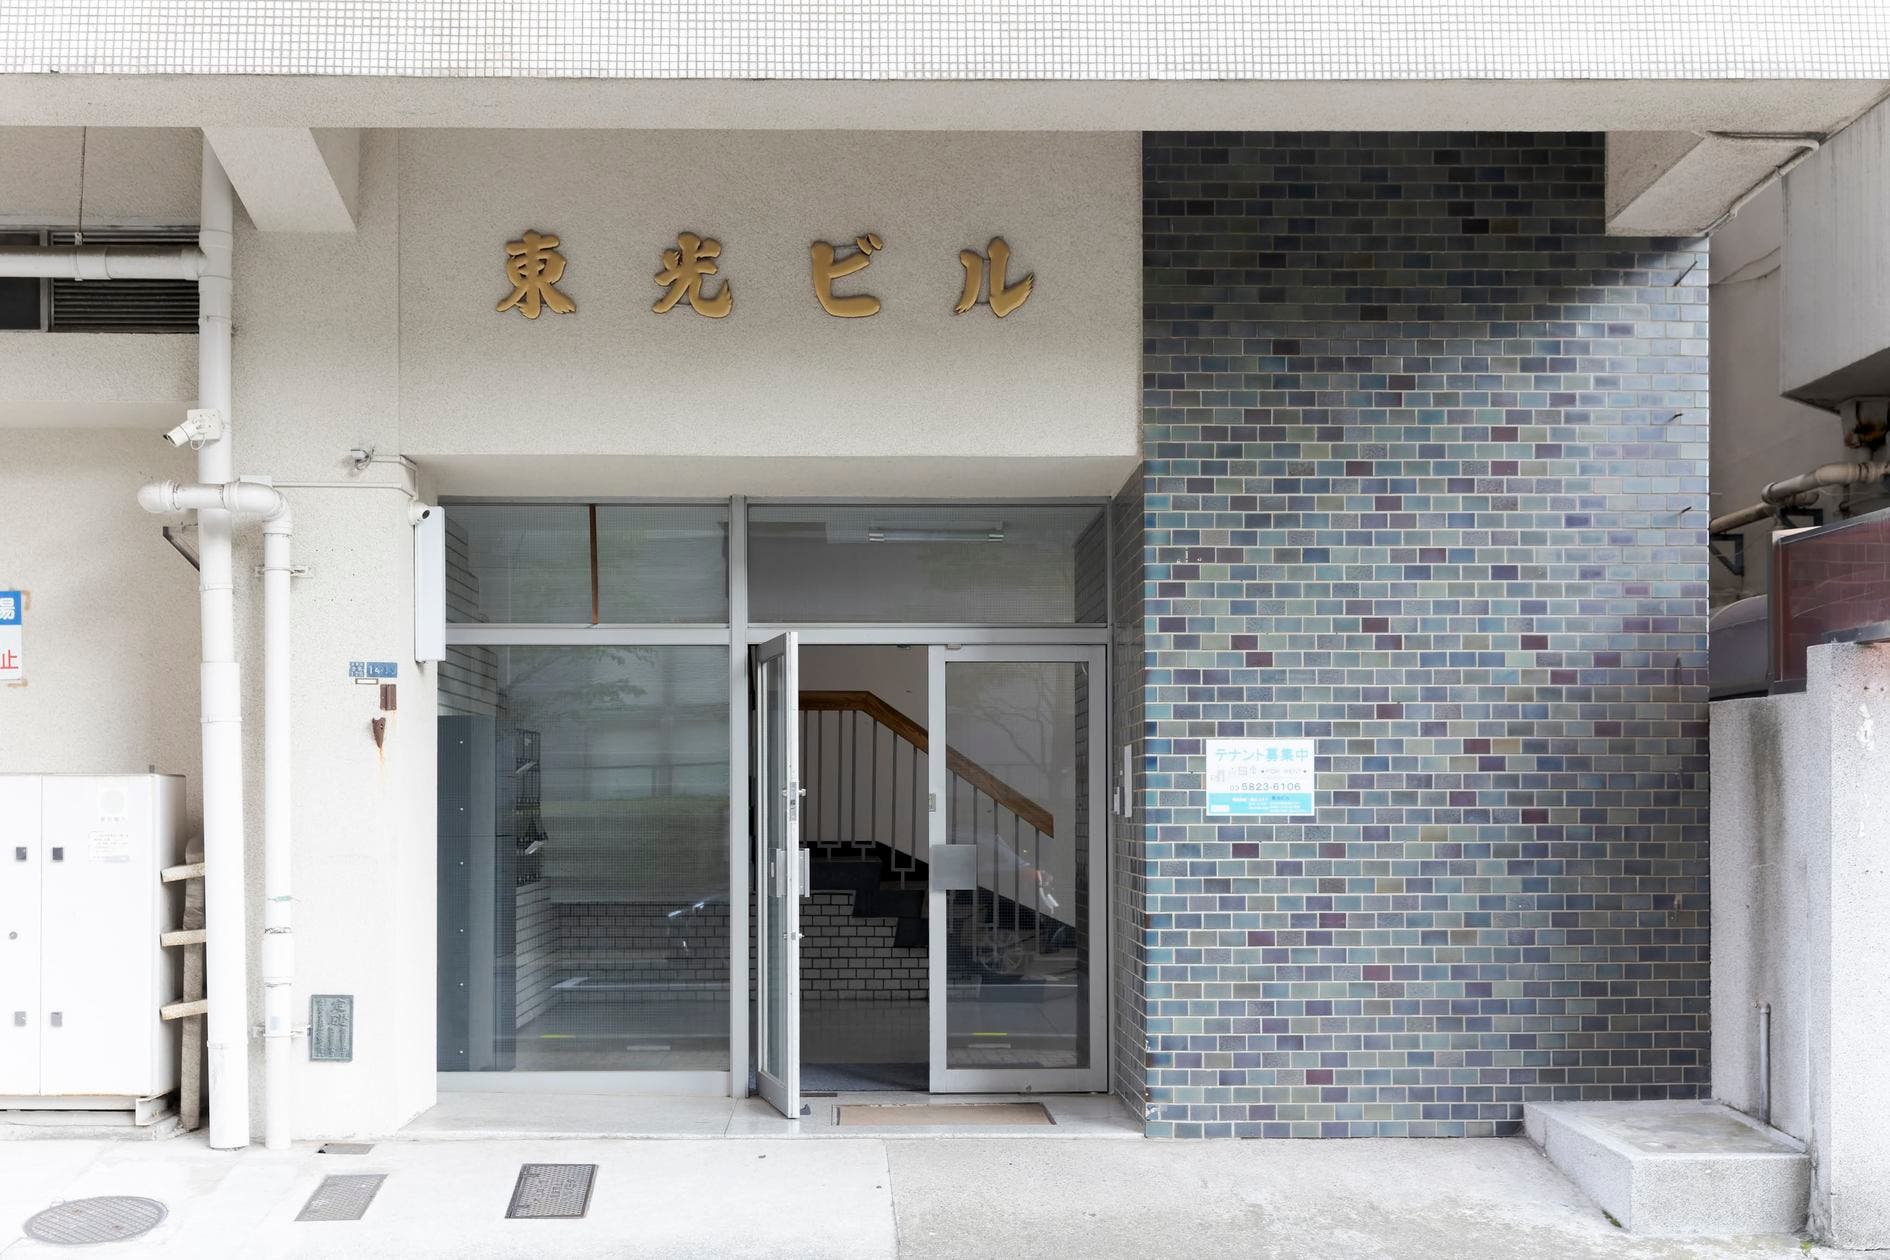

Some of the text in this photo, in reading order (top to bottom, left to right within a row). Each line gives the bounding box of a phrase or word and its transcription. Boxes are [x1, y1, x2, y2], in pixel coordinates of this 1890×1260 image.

[496, 229, 1036, 320] 東光ビル
[1215, 746, 1309, 762] テナント募集中
